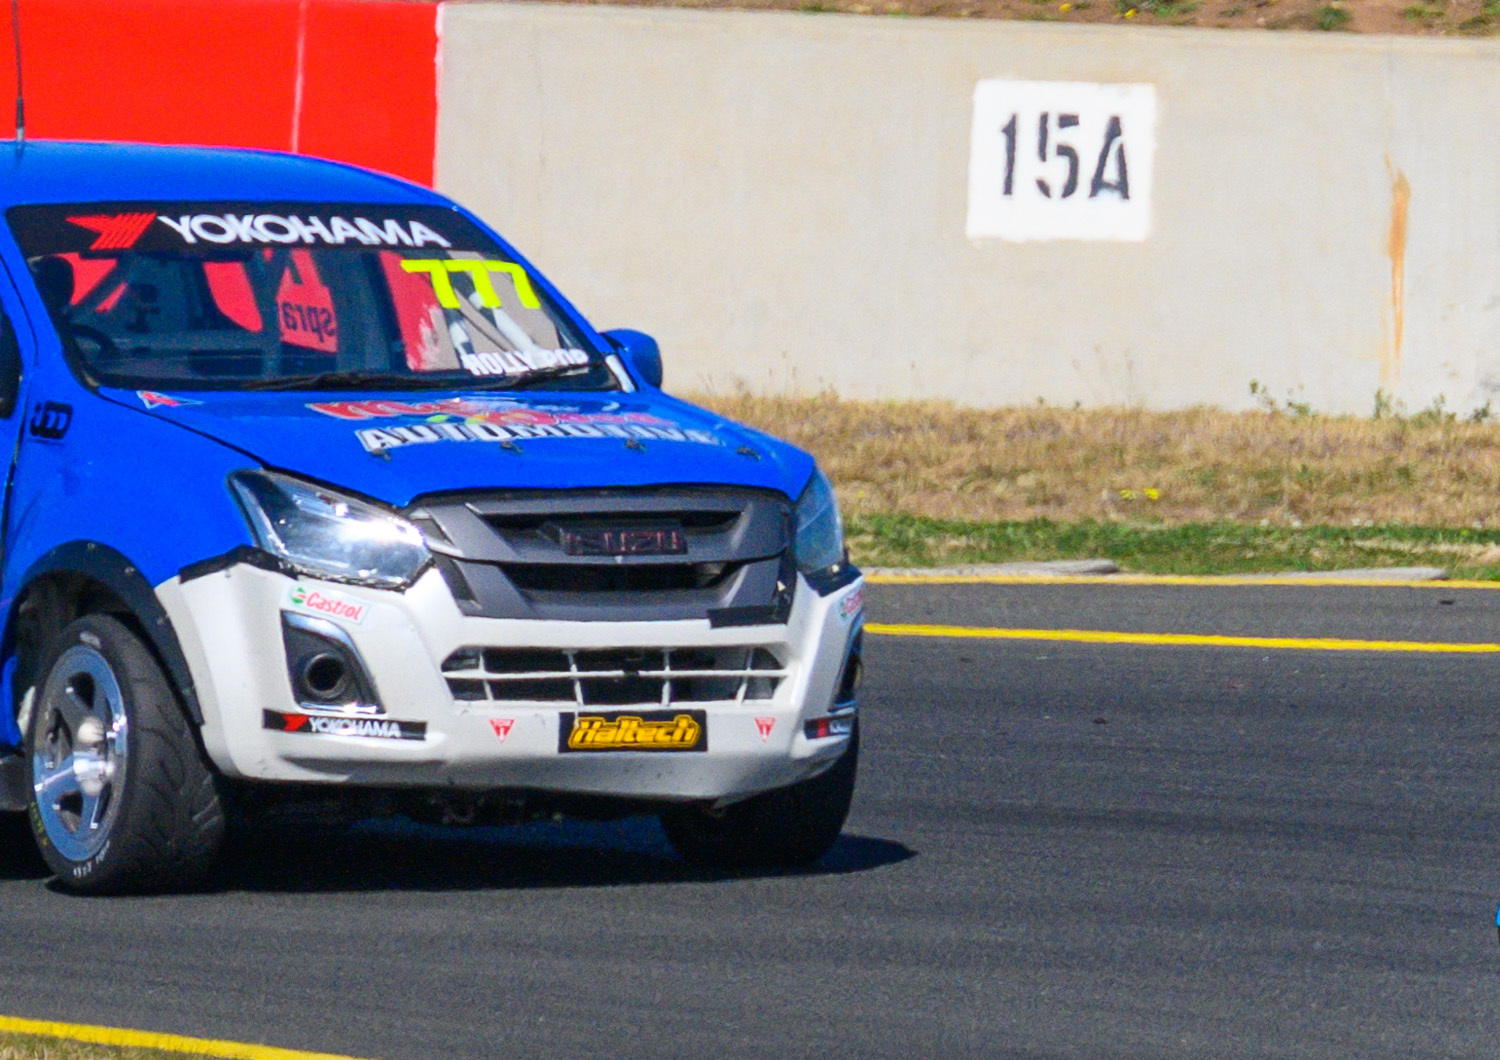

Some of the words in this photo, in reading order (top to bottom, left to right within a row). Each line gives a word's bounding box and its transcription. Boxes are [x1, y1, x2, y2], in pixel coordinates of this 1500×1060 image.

[1001, 111, 1130, 200] 15A
[157, 213, 451, 248] YOKOHAMA
[401, 260, 541, 309] 777
[306, 592, 363, 621] Castrol
[308, 717, 402, 738] YOKOHAMA
[570, 716, 696, 747] Haltech
